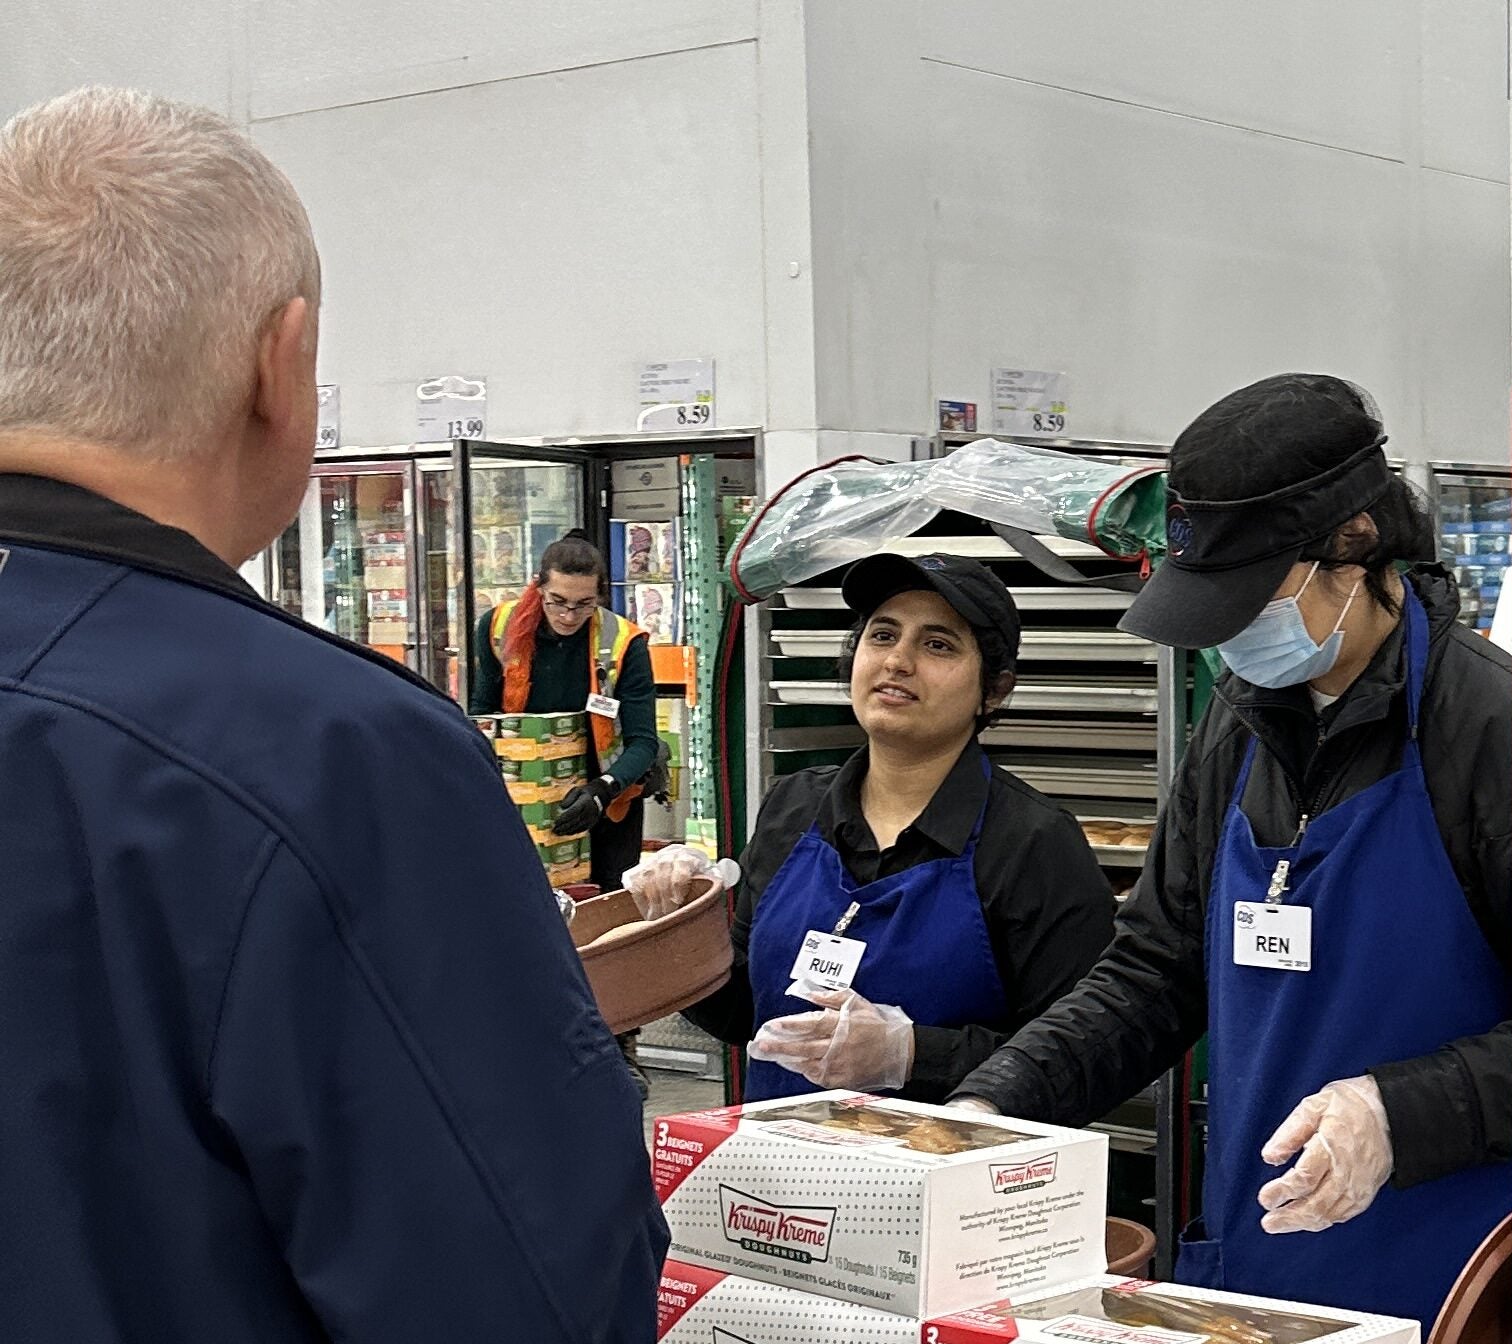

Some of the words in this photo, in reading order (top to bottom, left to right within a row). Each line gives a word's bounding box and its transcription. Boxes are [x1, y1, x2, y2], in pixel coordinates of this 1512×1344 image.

[677, 405, 710, 426] 8.59
[1033, 414, 1065, 432] 8.59
[448, 420, 483, 440] 13.99
[1256, 935, 1290, 955] REN
[809, 958, 843, 977] RUHI
[656, 1122, 669, 1147] 3
[727, 1201, 777, 1242] Krispy
[777, 1212, 828, 1247] Kreme
[657, 1291, 687, 1308] ATUITS
